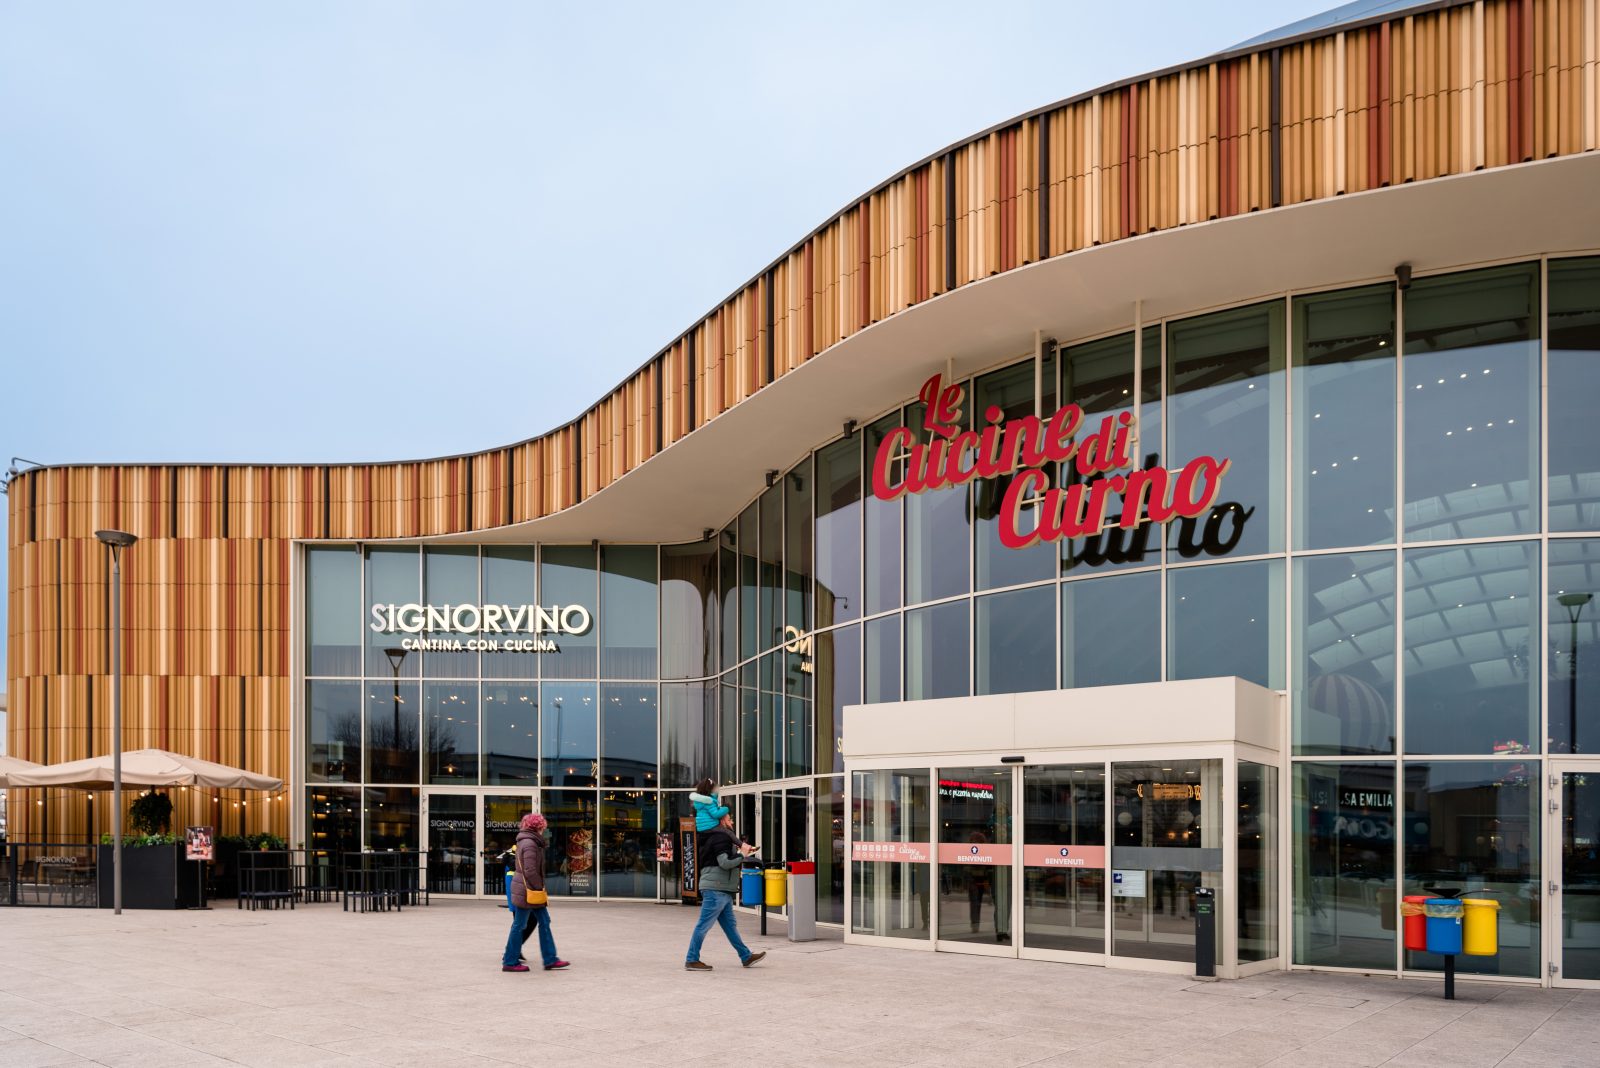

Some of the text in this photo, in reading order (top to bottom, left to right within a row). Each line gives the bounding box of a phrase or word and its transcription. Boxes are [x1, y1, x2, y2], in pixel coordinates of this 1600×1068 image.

[919, 373, 965, 440] Le
[872, 403, 1136, 501] Cucine di
[999, 455, 1233, 549] Curno
[370, 603, 590, 634] SIGNORVINO
[401, 638, 557, 652] CANTINA CON CUCINA
[1359, 793, 1393, 807] EMILIA
[430, 820, 475, 828] SIGNORVINO
[957, 855, 992, 863] BENVENUTI
[1045, 857, 1084, 865] BENVENUTI
